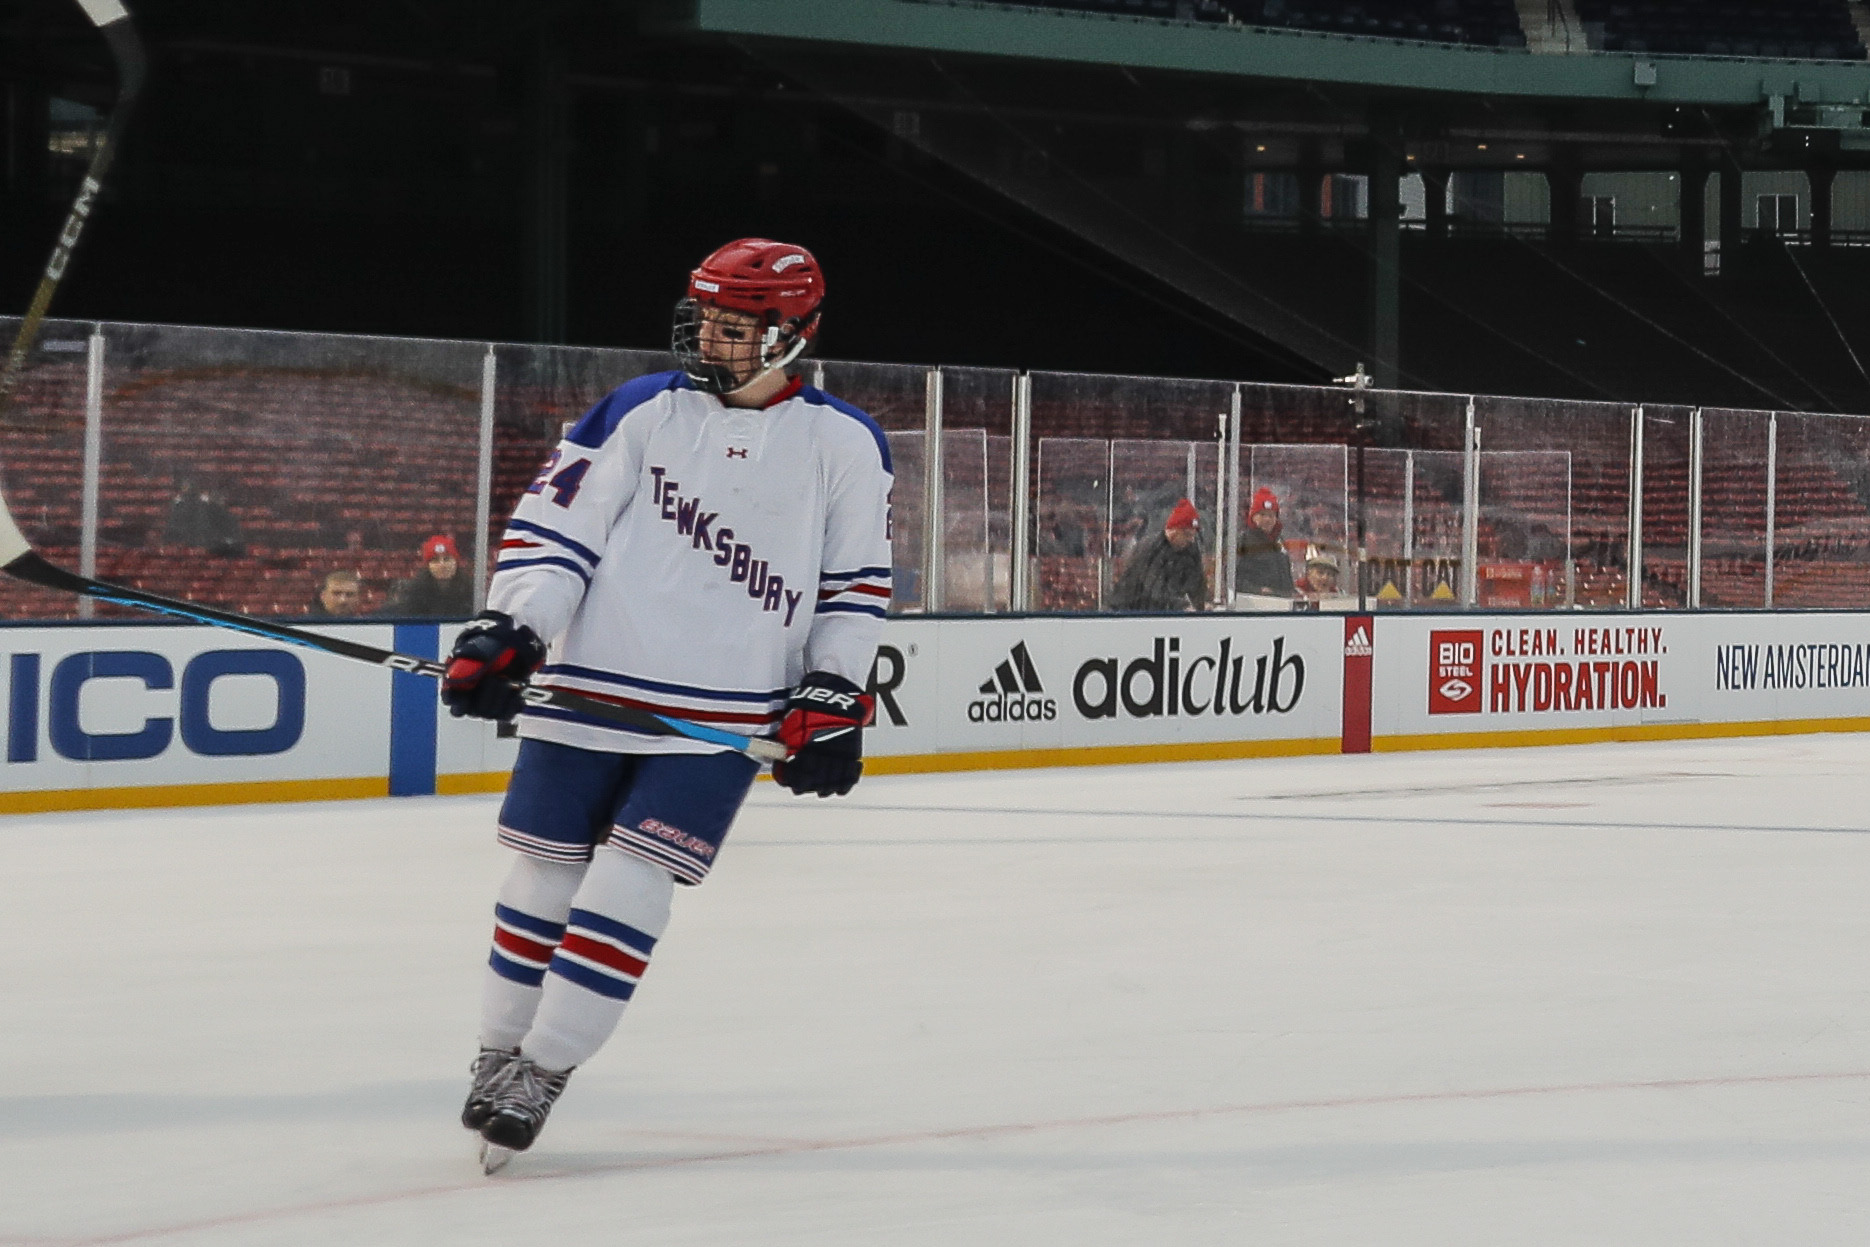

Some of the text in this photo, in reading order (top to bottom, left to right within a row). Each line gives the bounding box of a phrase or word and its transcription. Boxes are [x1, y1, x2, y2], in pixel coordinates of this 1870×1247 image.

[650, 466, 803, 628] TEWKSBURY
[1438, 642, 1475, 666] BIO
[1491, 627, 1668, 657] CLEAN. HEALTHY.
[1072, 635, 1307, 720] adiclub
[1438, 666, 1475, 678] STEEL
[1716, 644, 1759, 690] NEW
[1490, 660, 1667, 714] HYDRATION.
[967, 692, 1057, 723] adidas
